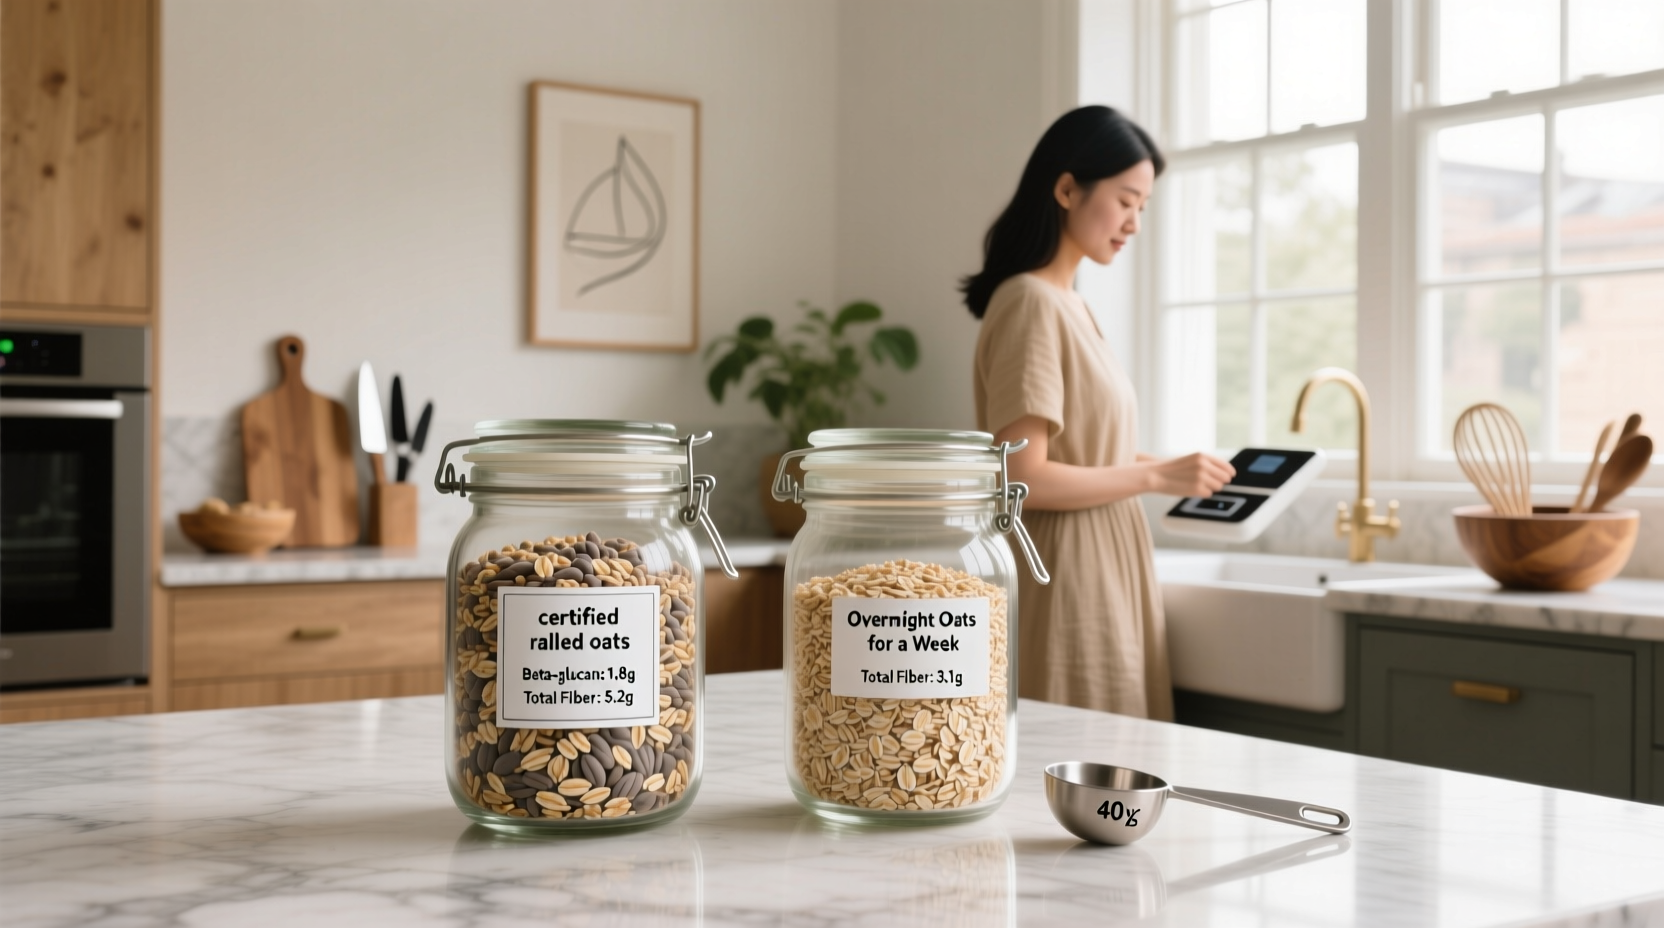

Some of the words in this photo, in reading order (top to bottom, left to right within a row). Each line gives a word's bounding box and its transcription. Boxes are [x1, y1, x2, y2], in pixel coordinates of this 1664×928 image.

[538, 606, 619, 626] certified
[847, 609, 935, 632] Overnight
[938, 610, 977, 628] Oats
[530, 631, 584, 651] ralled
[589, 632, 630, 650] oats
[867, 633, 894, 652] for
[897, 639, 908, 652] a
[912, 634, 960, 652] Week
[607, 666, 636, 684] 1.8g
[860, 669, 894, 684] Total
[523, 690, 557, 705] Total
[604, 689, 634, 707] 5.2g
